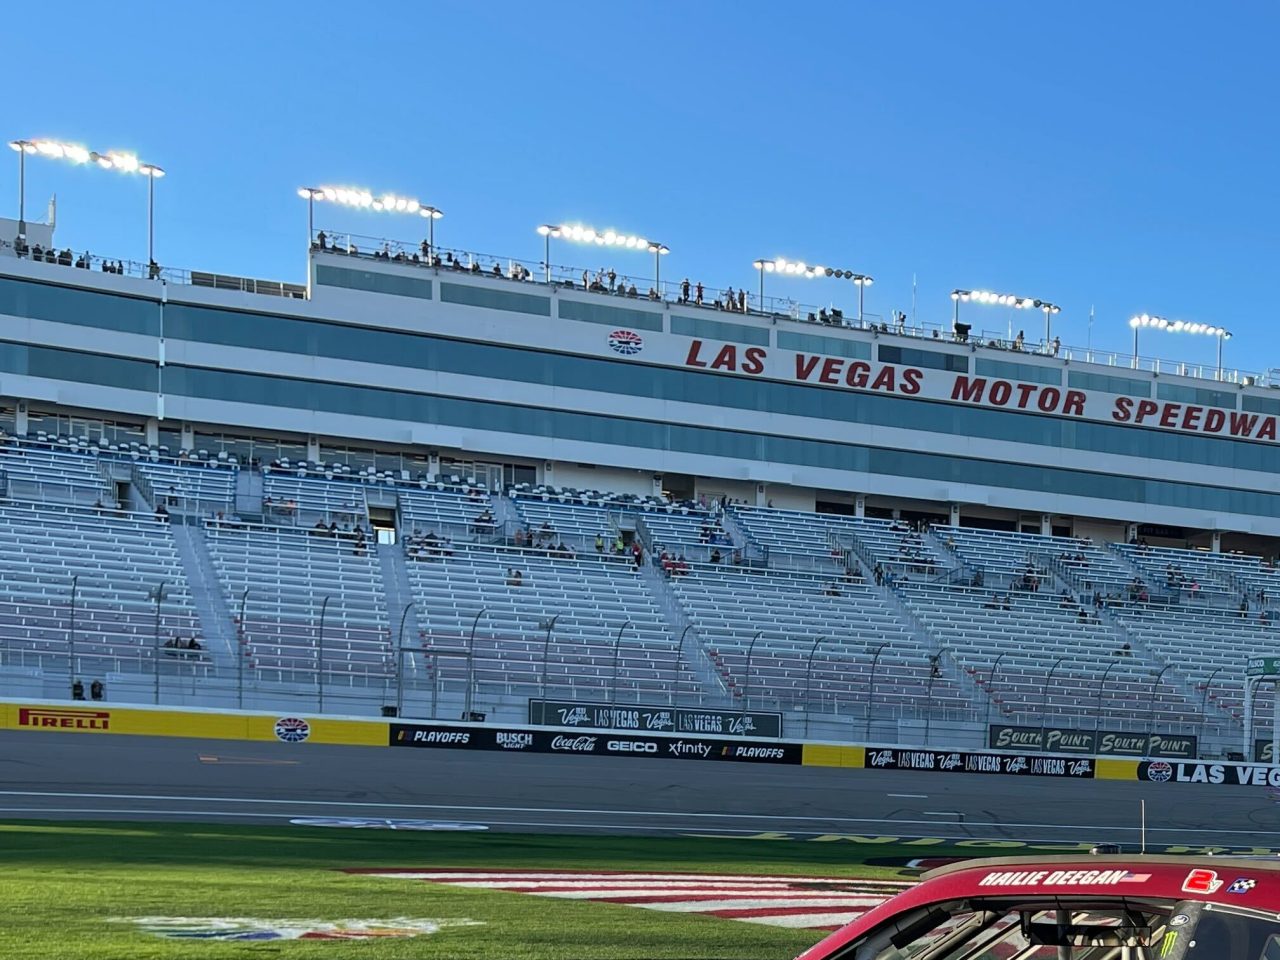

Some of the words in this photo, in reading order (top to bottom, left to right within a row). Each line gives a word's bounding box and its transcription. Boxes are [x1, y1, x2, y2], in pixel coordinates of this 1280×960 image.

[685, 339, 768, 376] LAS
[794, 353, 924, 395] VEGAS
[950, 375, 1088, 417] MOTOR
[19, 707, 110, 730] PIRELLI
[413, 730, 471, 744] PLAYOFFS
[496, 732, 533, 745] BUSCH
[607, 740, 658, 753] GEICO
[996, 728, 1042, 747] SOUTH
[1046, 730, 1093, 751] POINT
[1101, 734, 1145, 752] SOUTH
[1148, 736, 1192, 756] POINT
[668, 740, 712, 758] xfinity
[735, 746, 785, 759] PLAYOFFS
[910, 753, 935, 769] VEGAS
[977, 756, 1001, 772] VEGAS
[1043, 759, 1065, 775] VEGAS
[1176, 762, 1225, 784] LAS
[978, 871, 1047, 886] HAILIE
[1041, 869, 1128, 885] DEEGAN
